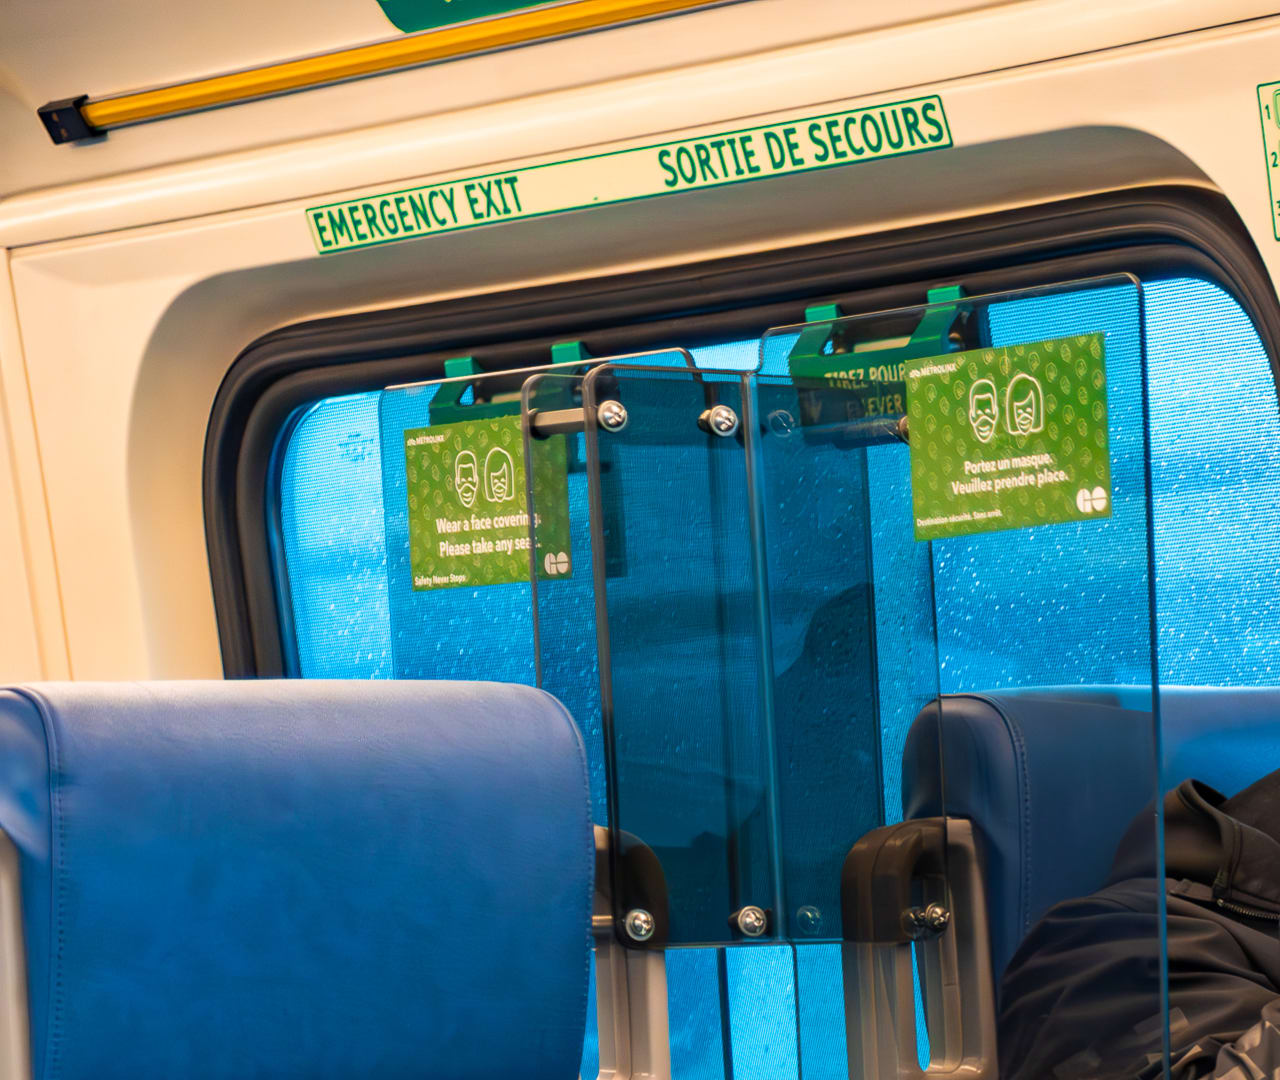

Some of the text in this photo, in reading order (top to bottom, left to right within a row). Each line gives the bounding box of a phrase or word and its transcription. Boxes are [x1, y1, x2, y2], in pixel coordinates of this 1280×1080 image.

[1265, 104, 1271, 120] 1
[658, 102, 944, 187] SORTIE DE SECOURS
[1271, 151, 1278, 168] 2
[313, 176, 522, 248] EMERGENCY EXIT
[963, 453, 1053, 475] Portez un masque.
[951, 468, 1069, 495] Veuillez prendre place.
[435, 516, 462, 534] Wear
[463, 519, 469, 532] a
[470, 514, 491, 531] face
[439, 541, 471, 557] Please
[472, 537, 494, 553] take
[495, 539, 513, 555] any
